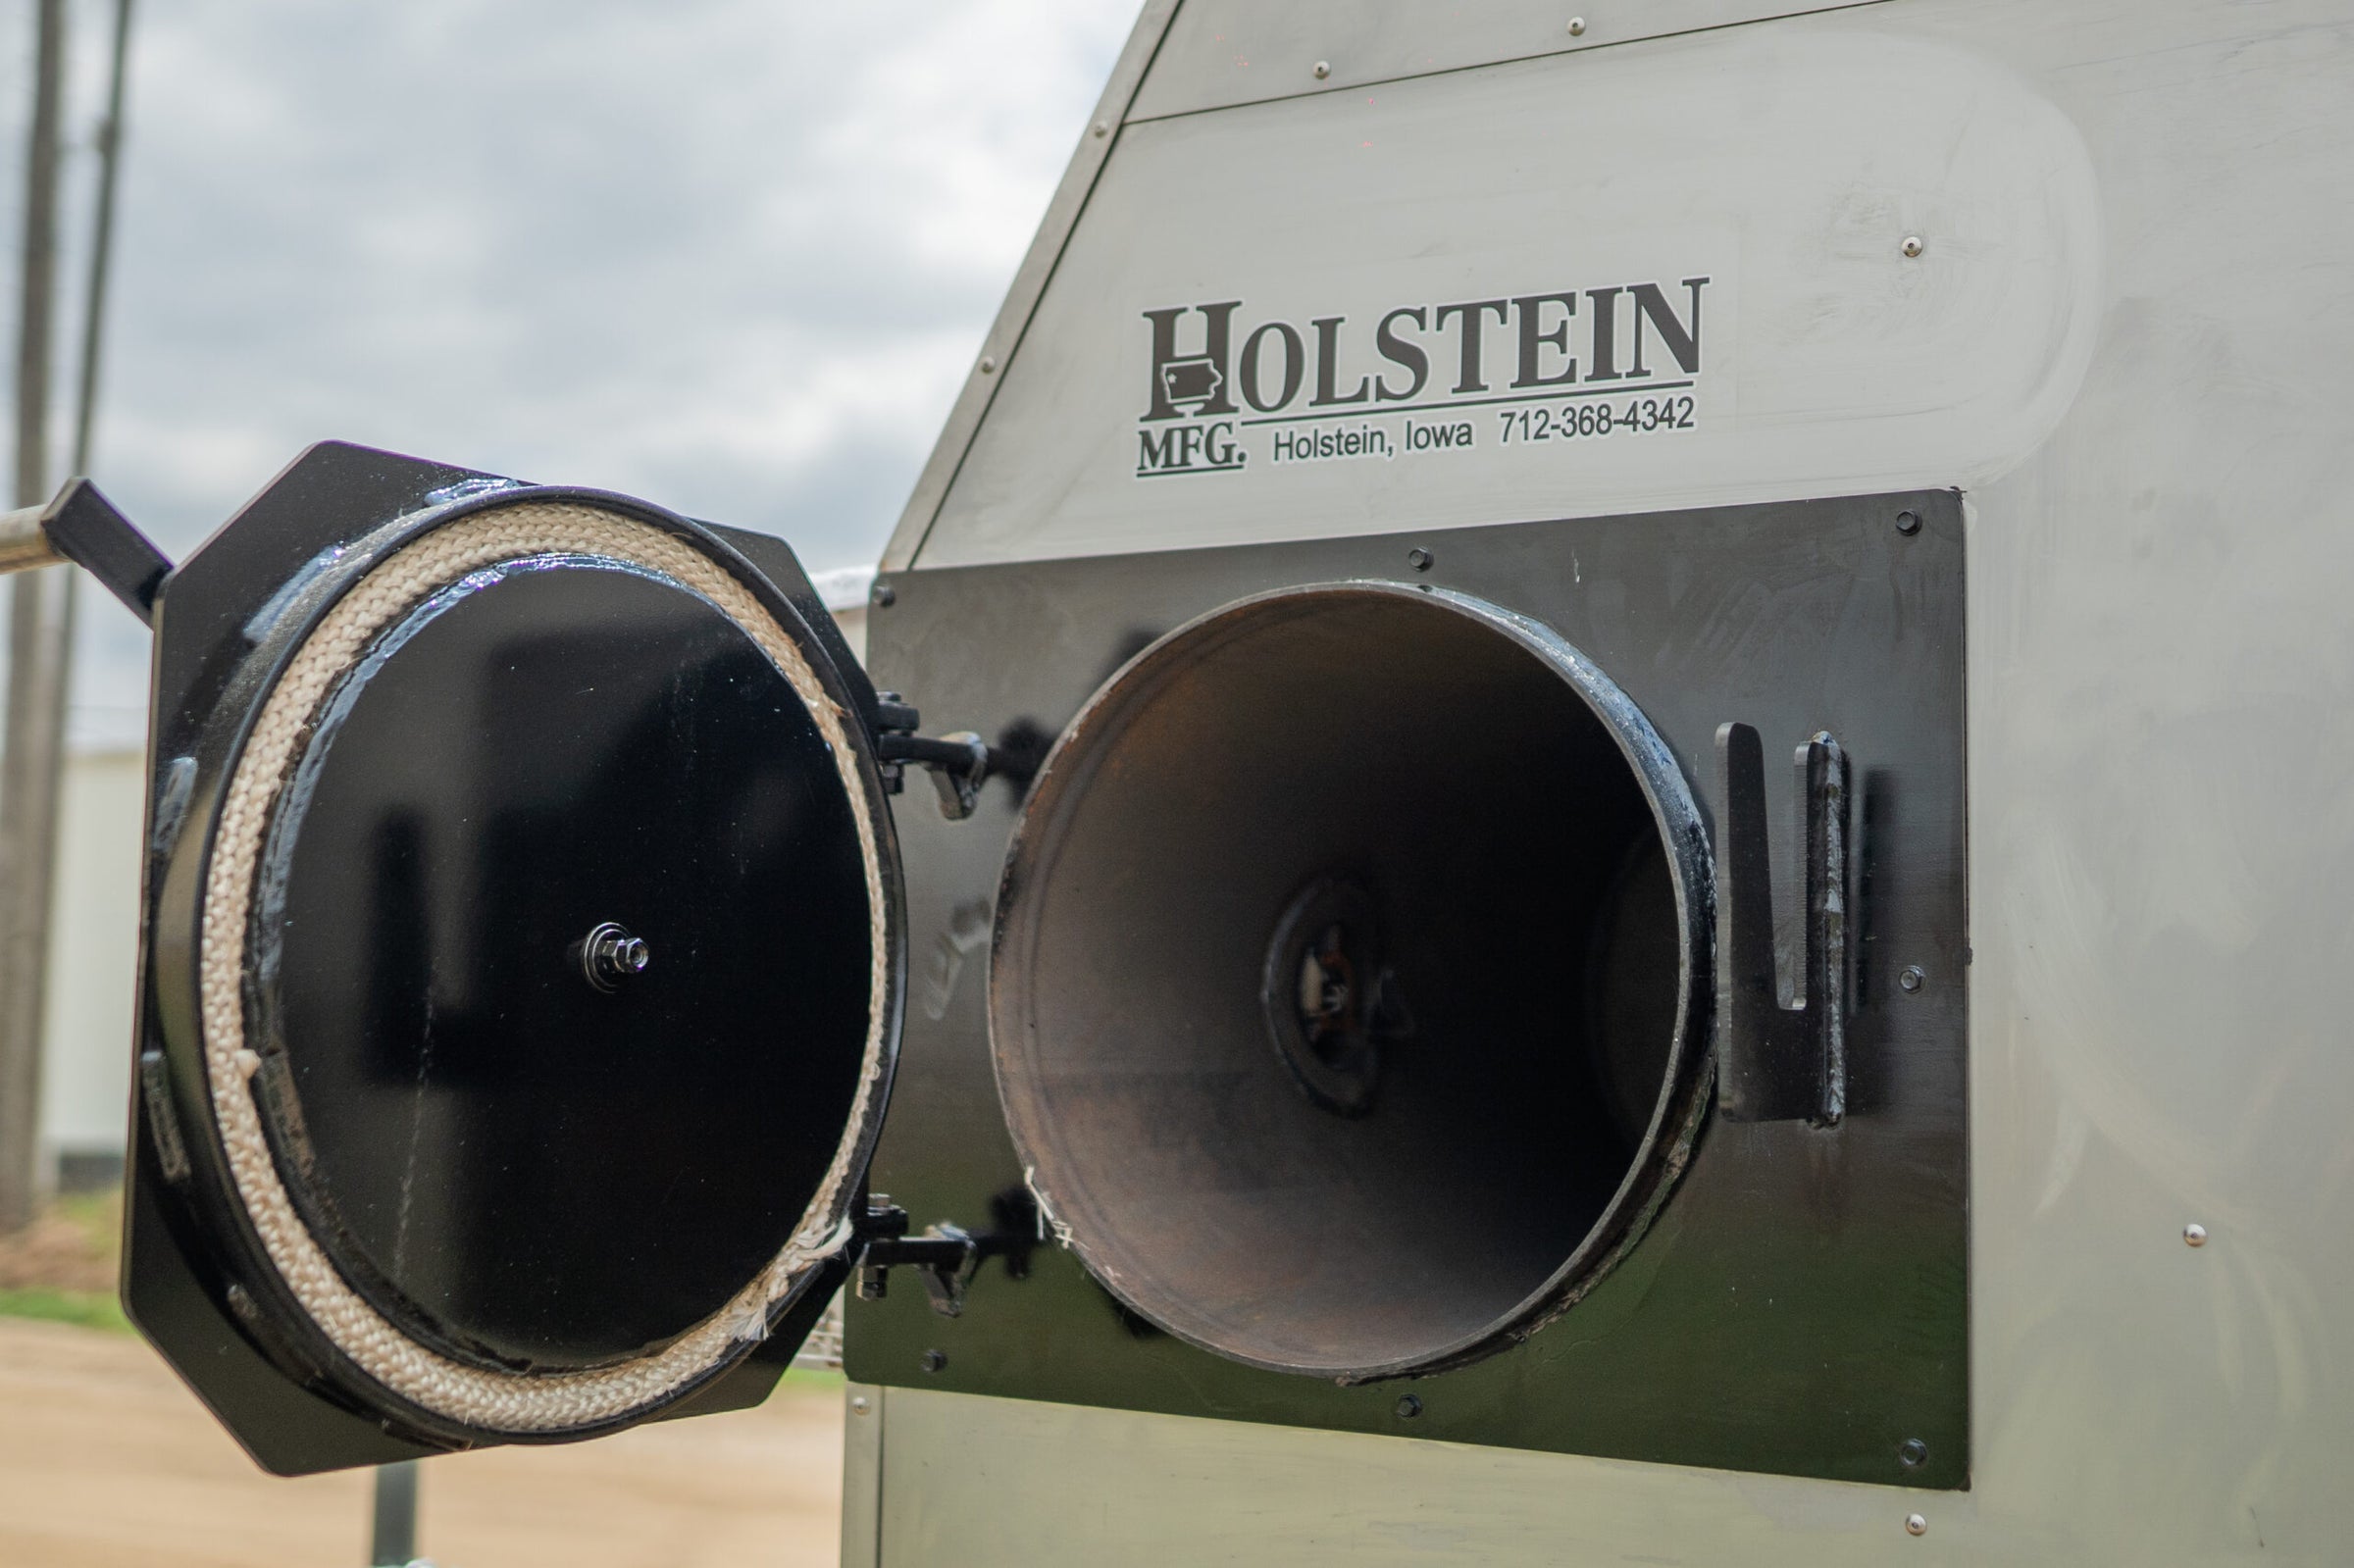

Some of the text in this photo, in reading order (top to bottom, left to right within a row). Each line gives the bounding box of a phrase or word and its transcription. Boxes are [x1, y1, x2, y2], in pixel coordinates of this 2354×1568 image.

[1139, 277, 1710, 422] HOLSTEIN
[1138, 396, 1694, 470] MFG. Holstein, Iowa 712-368-4342
